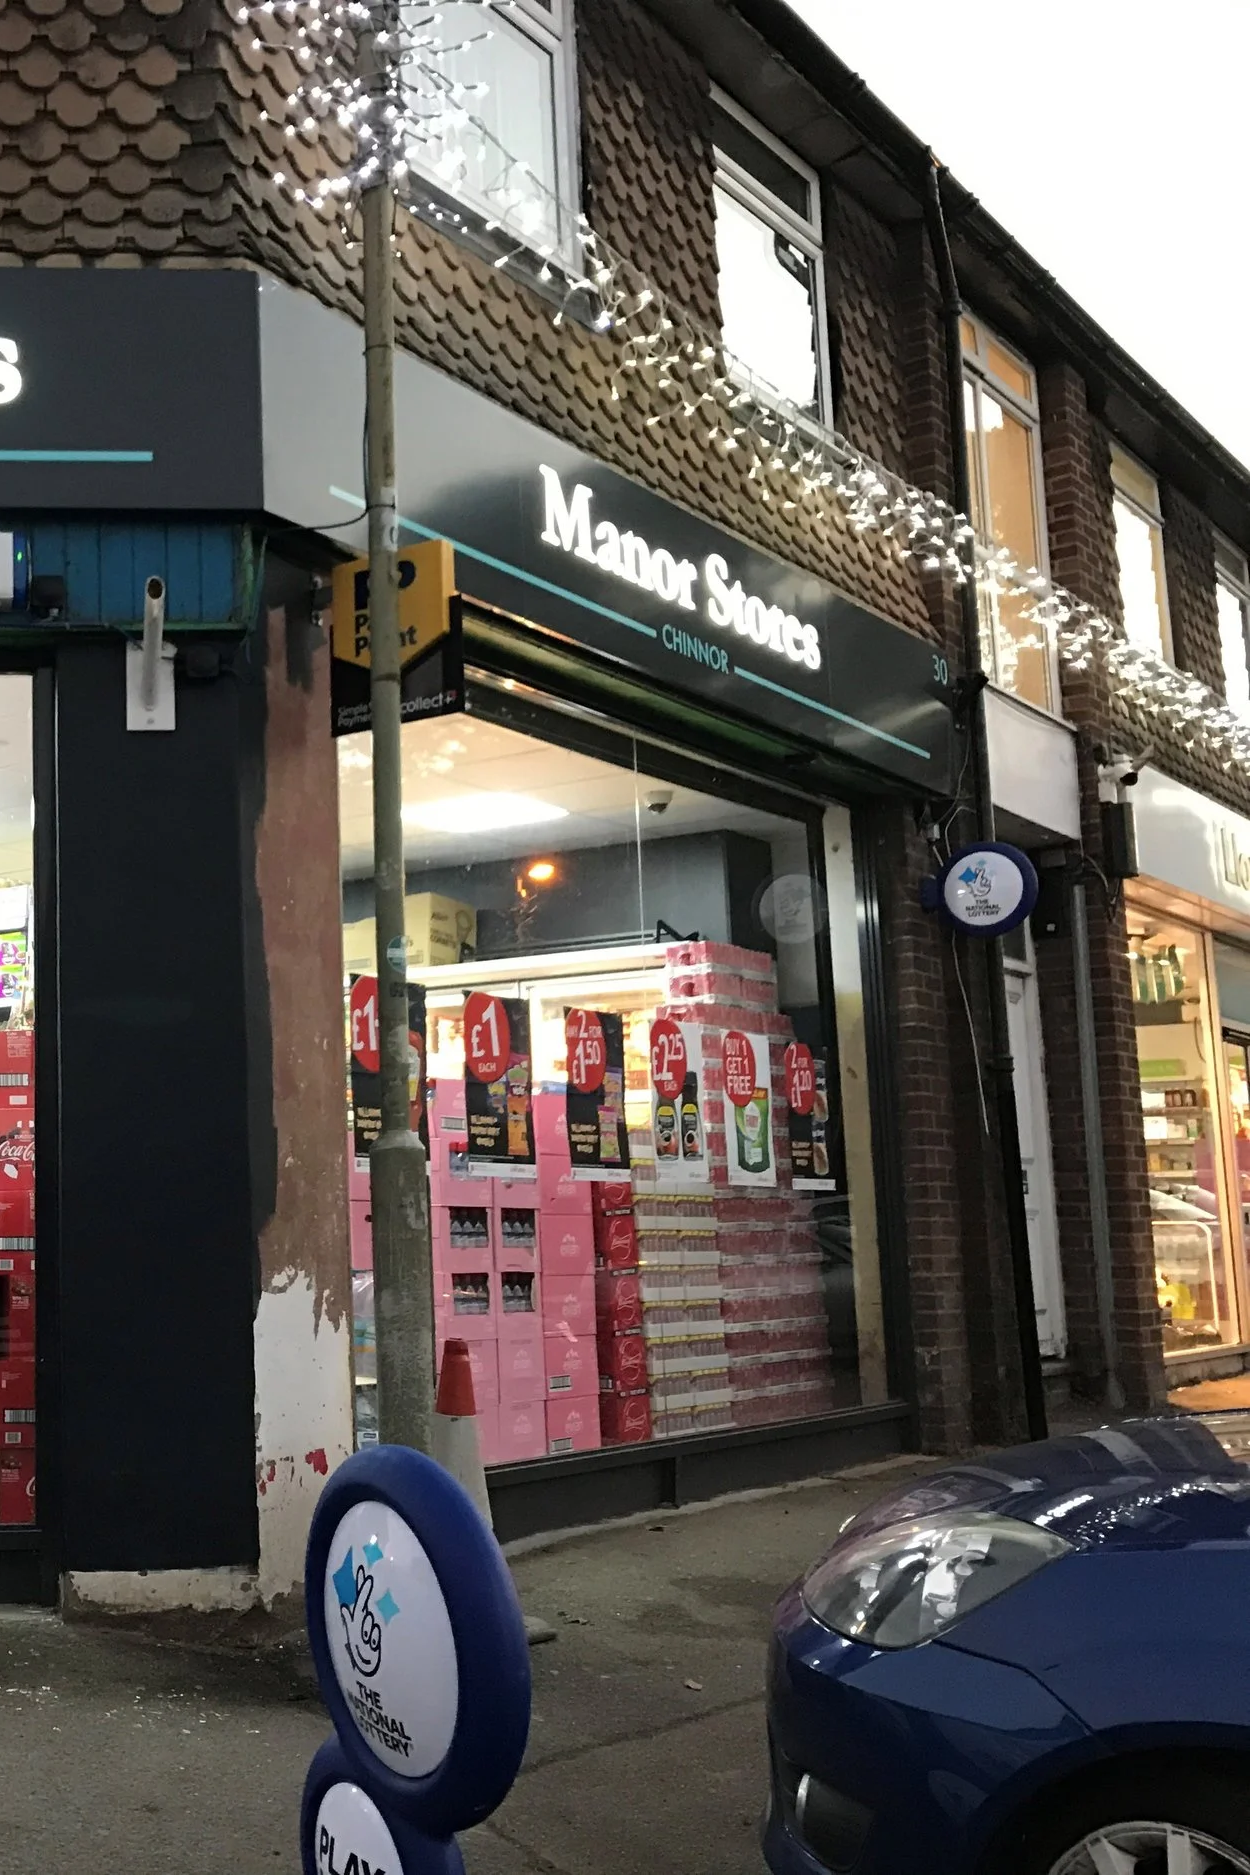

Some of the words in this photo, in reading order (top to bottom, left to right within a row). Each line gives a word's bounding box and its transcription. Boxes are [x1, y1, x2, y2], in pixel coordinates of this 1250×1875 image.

[538, 464, 697, 611] Manor
[704, 553, 822, 670] Stores
[662, 623, 729, 675] CHINNOR
[932, 655, 948, 685] 30
[965, 903, 1001, 912] NATIONAL
[968, 909, 1000, 918] LOTTERY
[471, 1001, 500, 1058] £1
[578, 1010, 588, 1038] 2
[726, 1038, 740, 1055] BUY
[742, 1040, 748, 1056] 1
[790, 1044, 797, 1068] 2
[479, 1062, 496, 1073] EACH
[726, 1057, 742, 1074] GET
[744, 1058, 750, 1074] 1
[727, 1075, 752, 1095] FREE
[357, 1680, 382, 1710] THE
